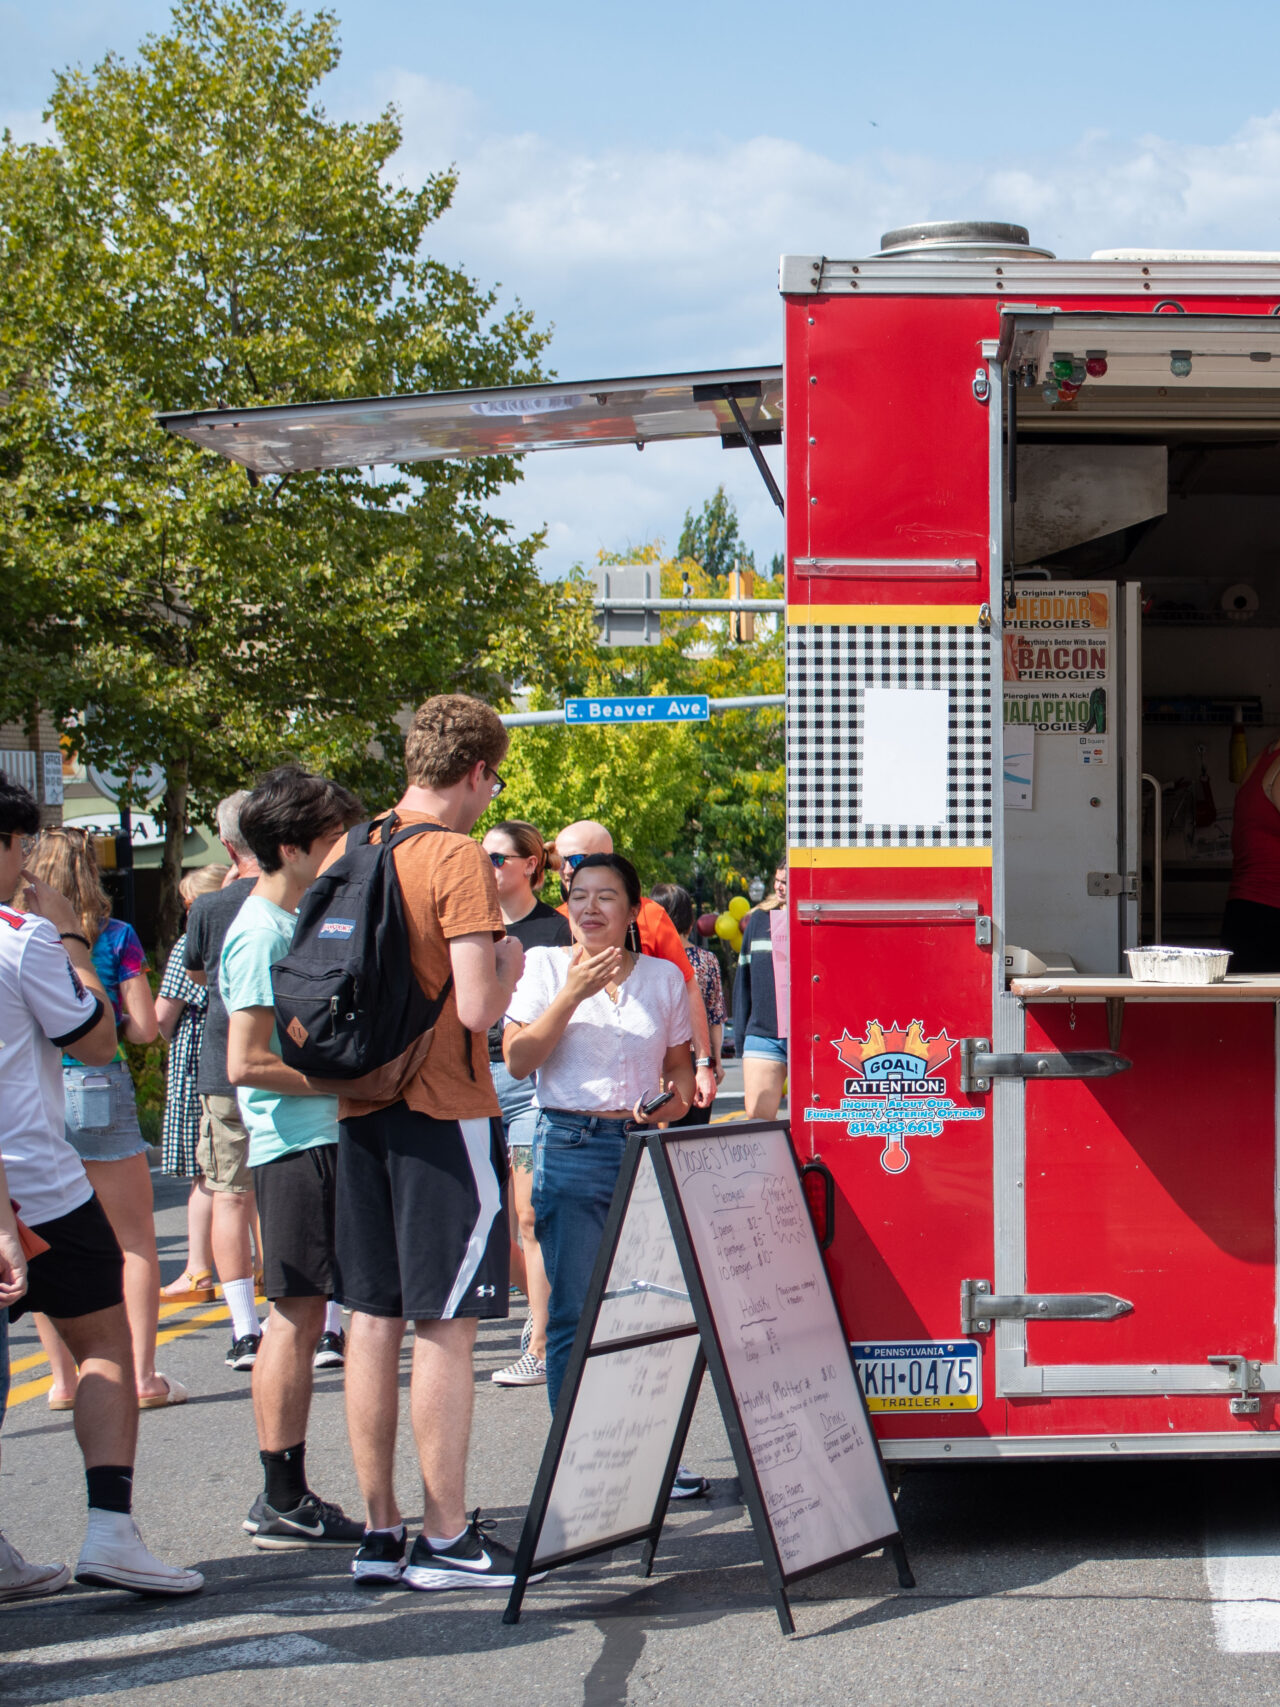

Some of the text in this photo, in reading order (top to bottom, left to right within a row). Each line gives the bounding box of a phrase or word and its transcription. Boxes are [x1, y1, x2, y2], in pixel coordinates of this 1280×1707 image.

[1022, 590, 1056, 598] Original
[1003, 620, 1091, 629] PIEROGIES
[1018, 647, 1106, 670] BACON
[1018, 670, 1106, 679] PIEROGIES
[567, 701, 706, 719] E. Beaver Ave.
[870, 1058, 918, 1074] GOAL!
[849, 1080, 944, 1093] ATTENTION:
[842, 1099, 951, 1110] INQUIRE ABOUT OUR
[885, 1109, 934, 1119] CATERING
[937, 1108, 983, 1119] OPTIONS
[850, 1121, 942, 1135] 814.883.6615
[874, 1347, 945, 1357] PENNSYLVANIA
[880, 1397, 941, 1408] TRAILER
